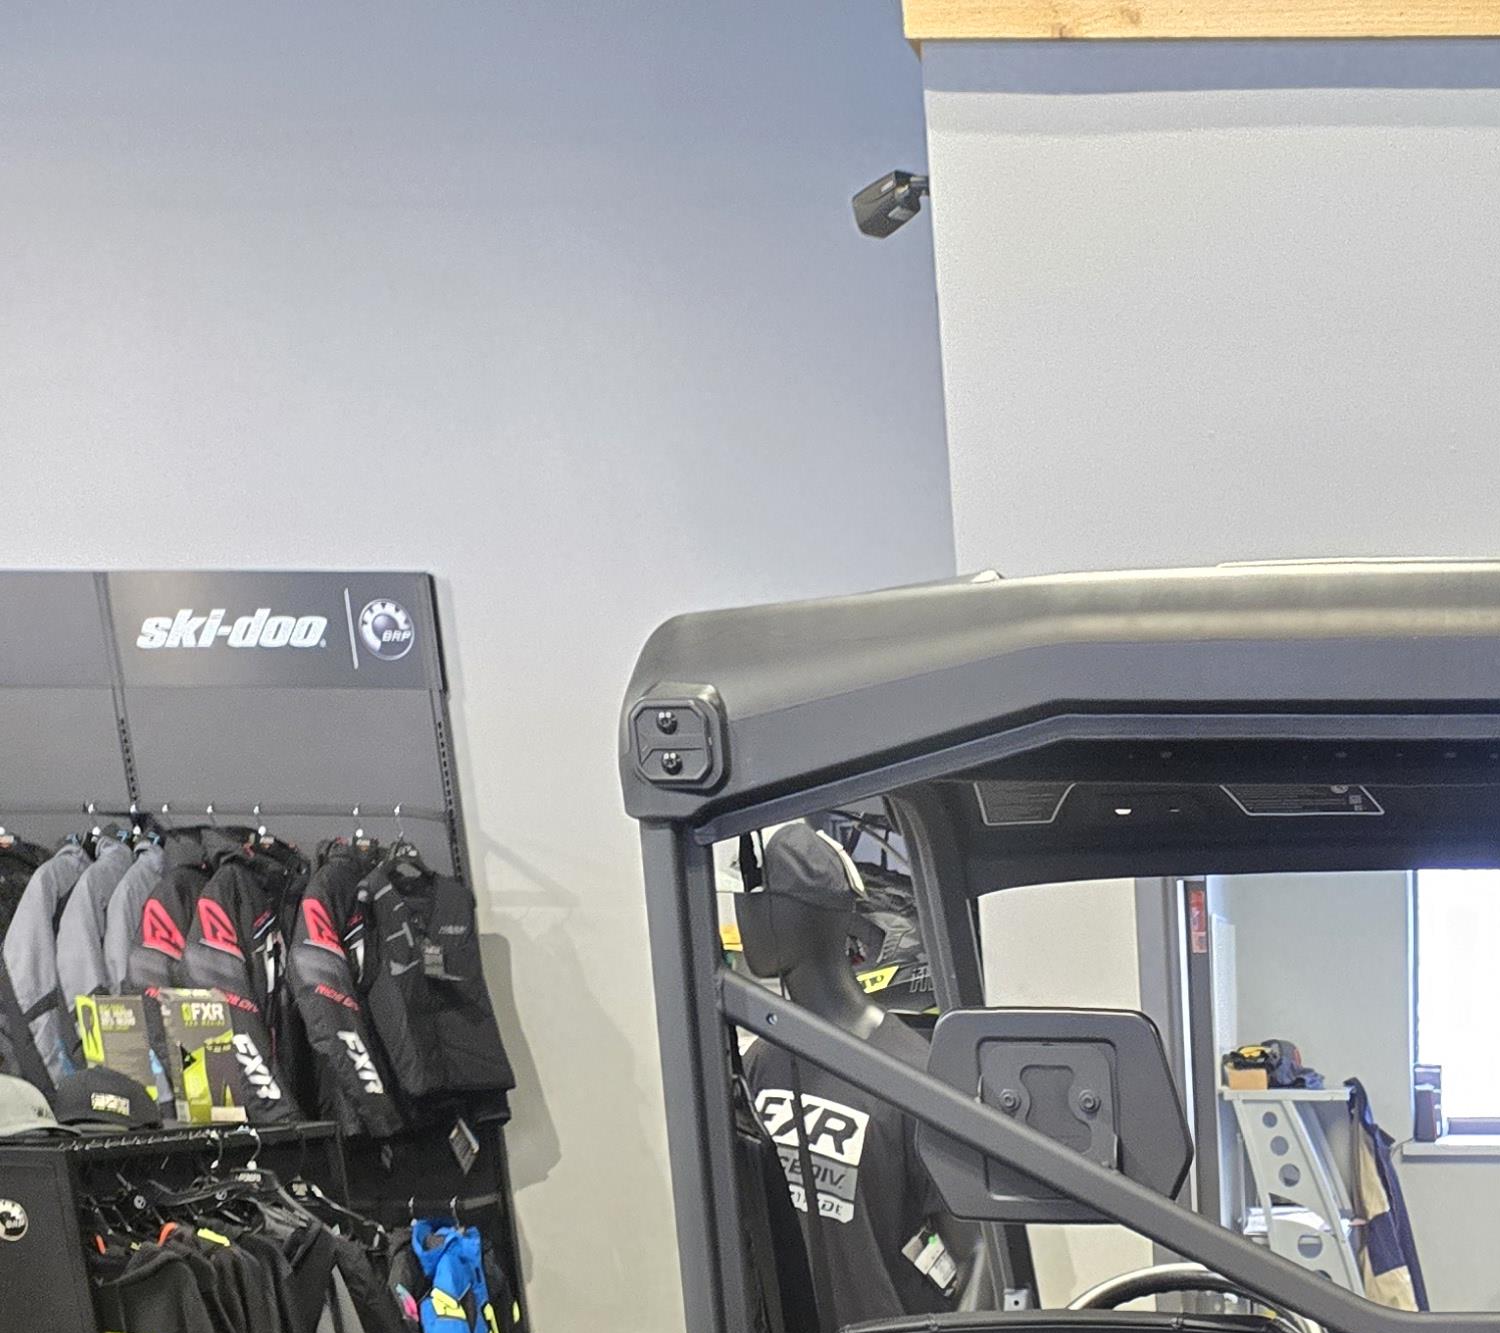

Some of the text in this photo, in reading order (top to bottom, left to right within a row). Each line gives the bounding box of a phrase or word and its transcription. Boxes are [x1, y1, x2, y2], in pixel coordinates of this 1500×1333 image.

[136, 608, 327, 648] ski-doo
[381, 629, 412, 643] BRP
[337, 1031, 385, 1094] FXR
